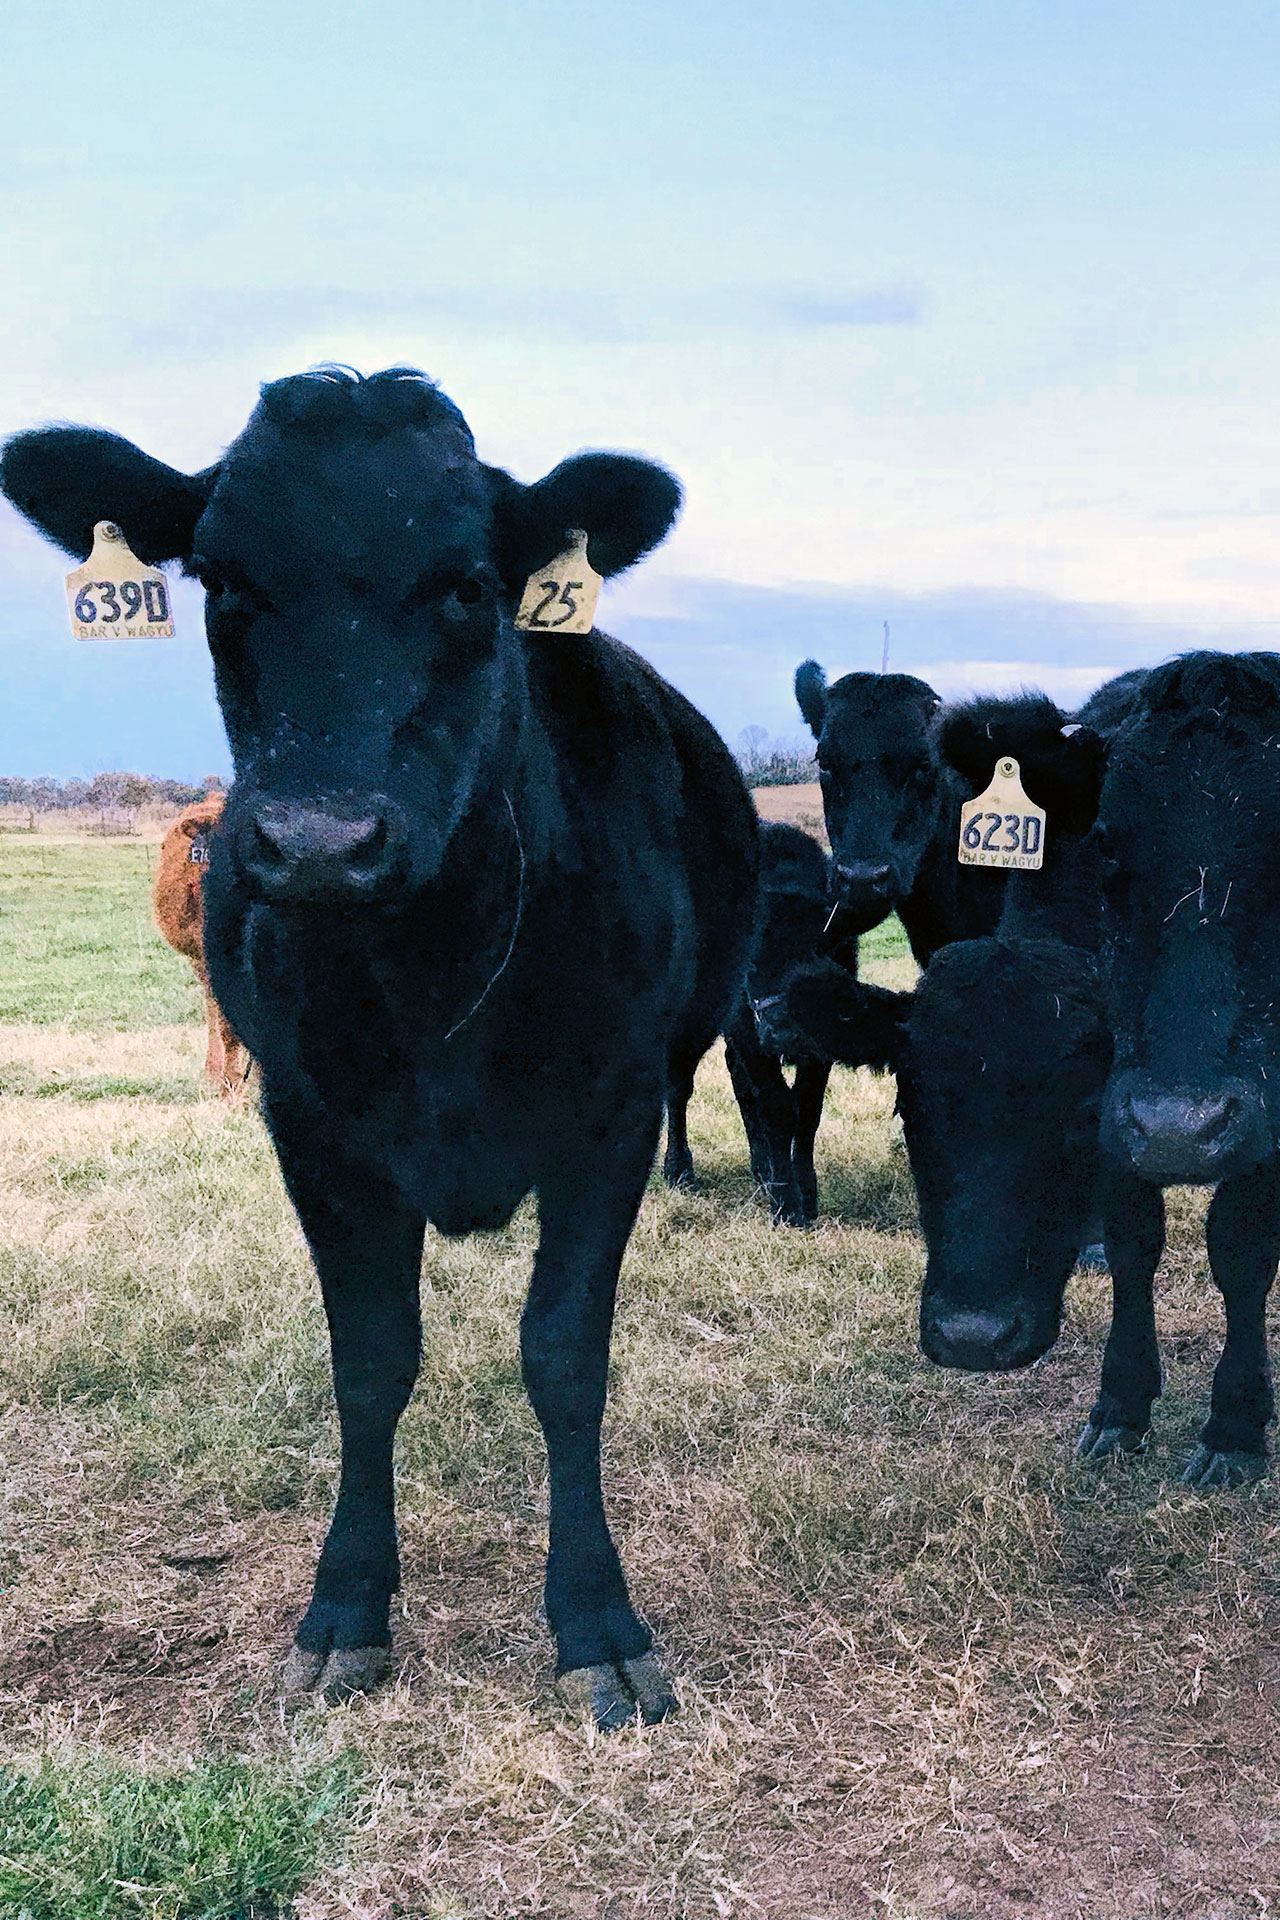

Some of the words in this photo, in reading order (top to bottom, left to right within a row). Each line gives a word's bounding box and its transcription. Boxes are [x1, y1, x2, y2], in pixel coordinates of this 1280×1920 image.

[75, 580, 169, 623] 639D
[528, 580, 583, 628] 25
[79, 625, 107, 638] BAR
[123, 624, 173, 637] WAGYU
[962, 812, 1041, 855] 623D
[962, 852, 986, 865] BAR
[1001, 856, 1041, 868] WAGYU
